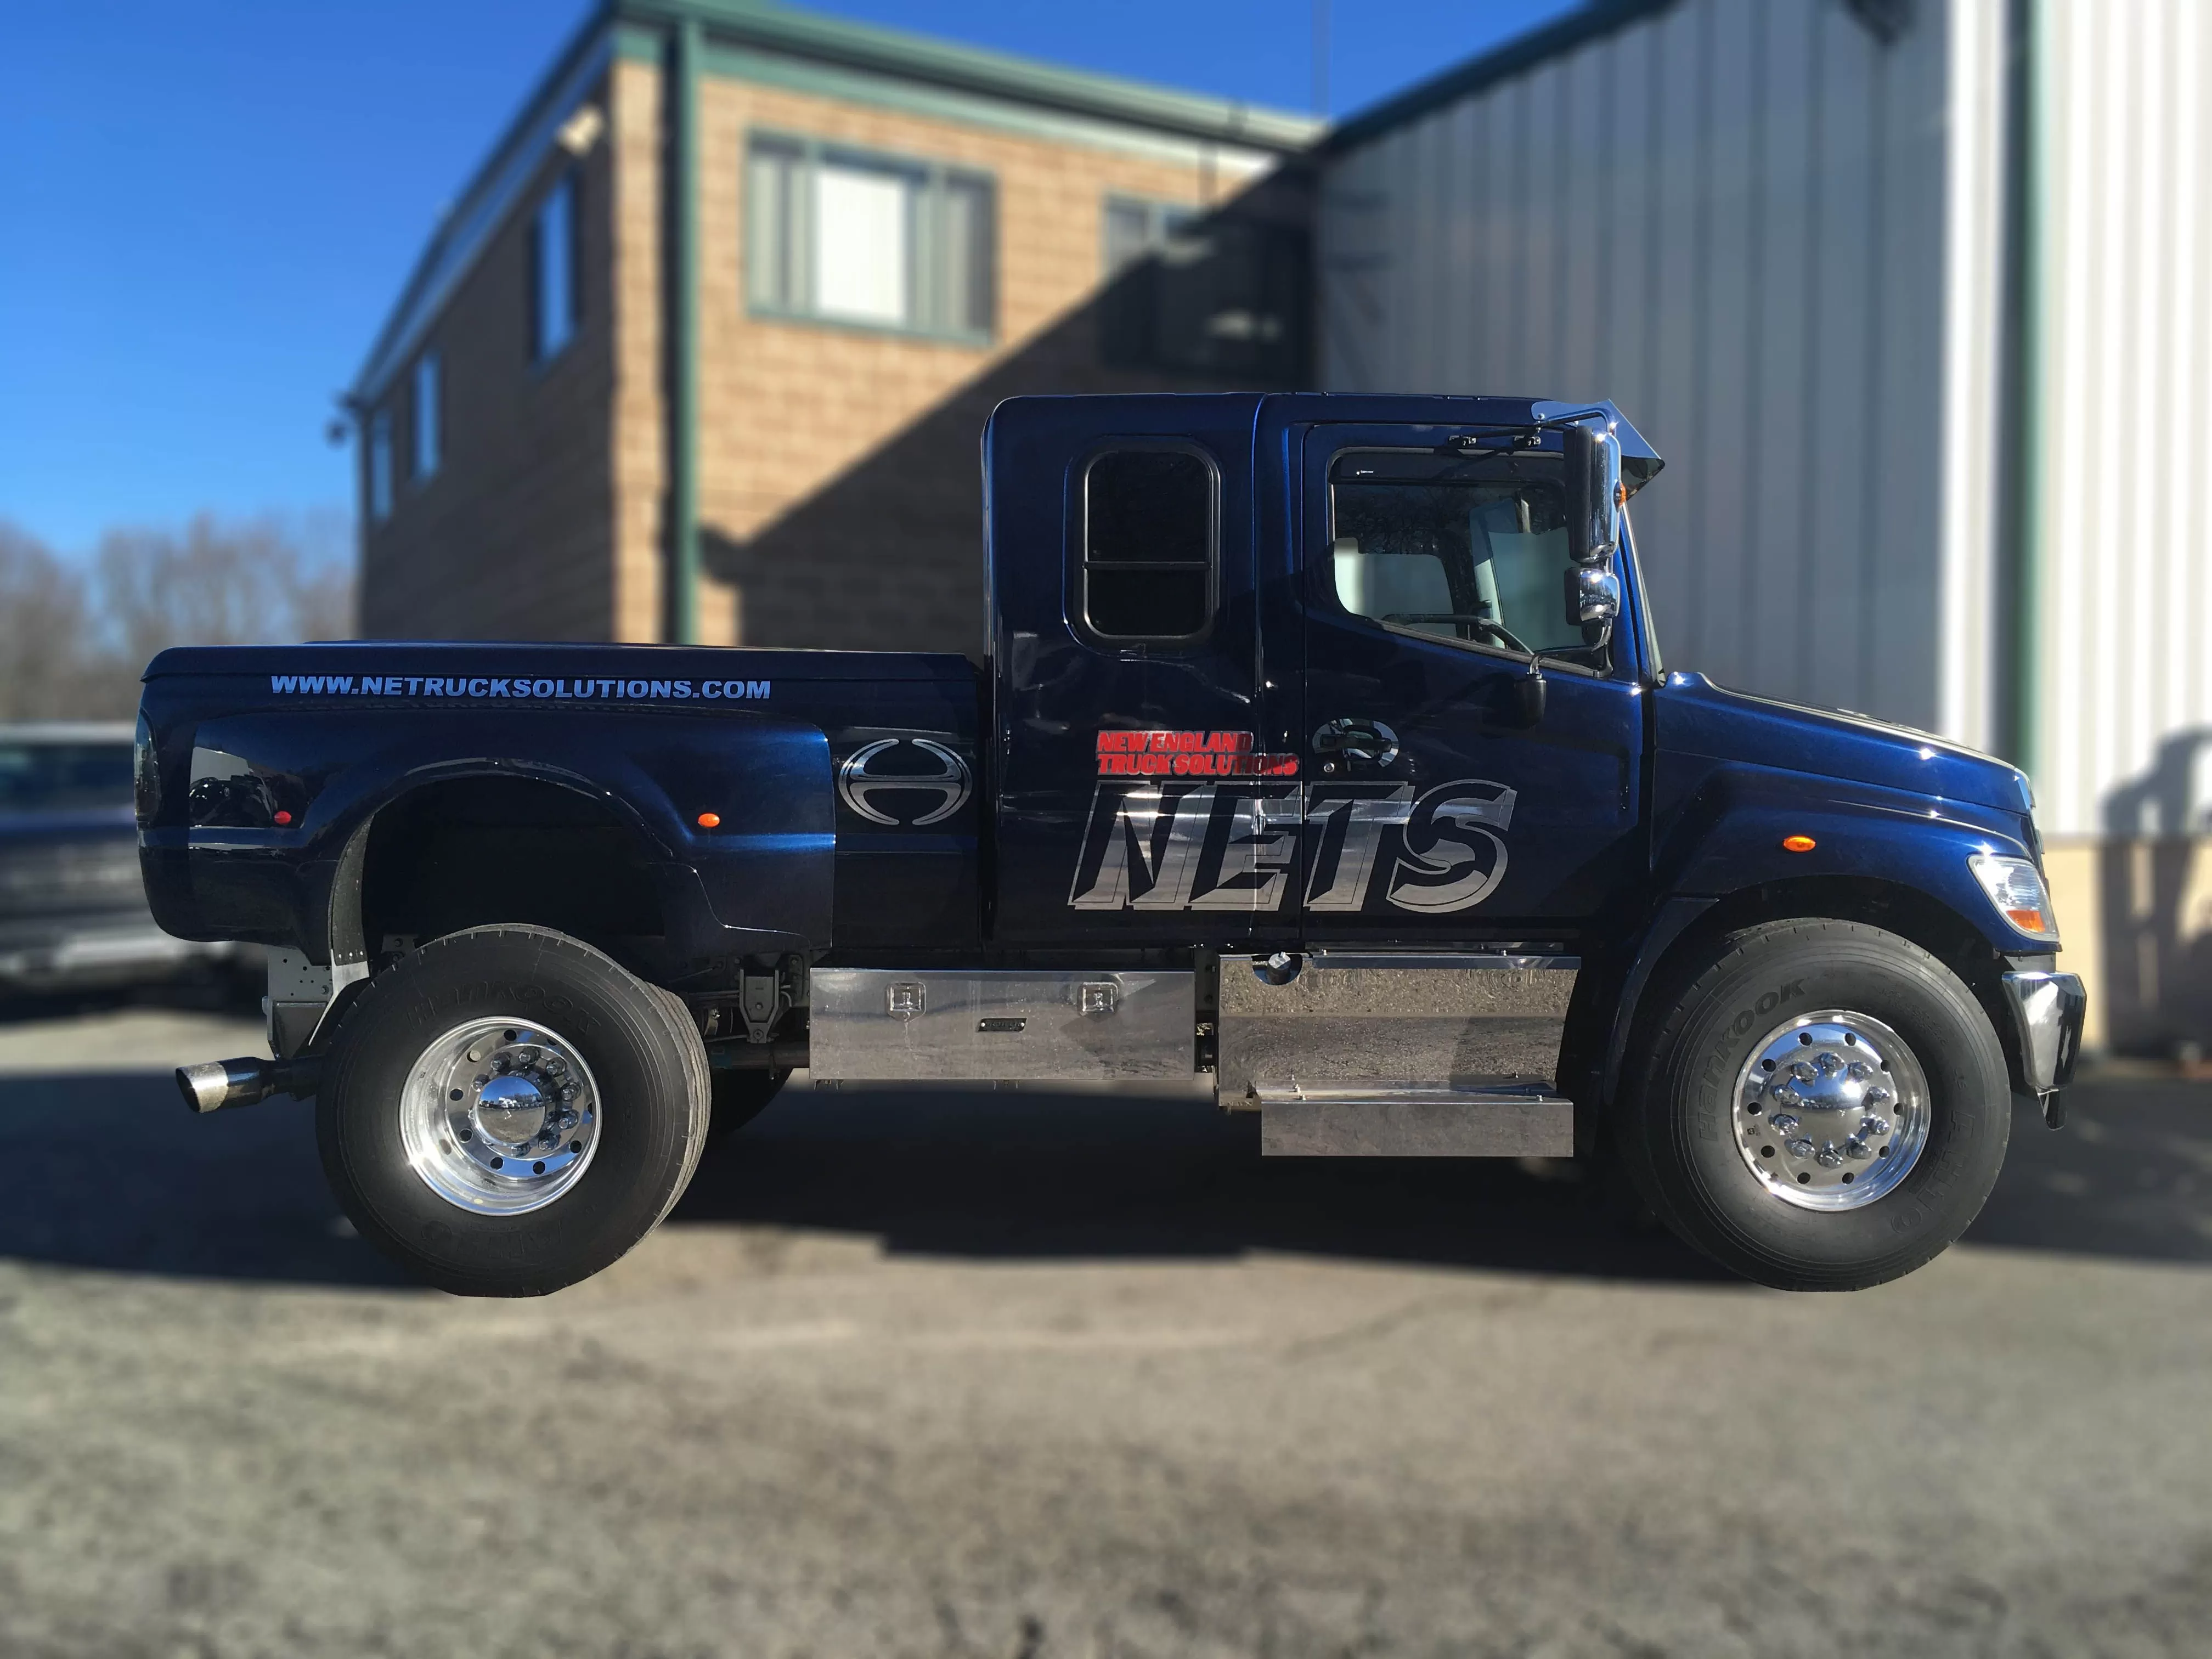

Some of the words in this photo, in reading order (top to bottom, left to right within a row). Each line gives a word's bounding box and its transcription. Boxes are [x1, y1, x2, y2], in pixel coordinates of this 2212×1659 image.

[271, 675, 771, 699] WWW.NETRUCKSOLUTIONS.COM
[1097, 731, 1146, 752] NEW
[1148, 731, 1254, 752] ENGLAND
[1097, 754, 1173, 775] TRUCK
[1173, 754, 1299, 775] SOLUTIONS
[1067, 778, 1518, 913] NETS
